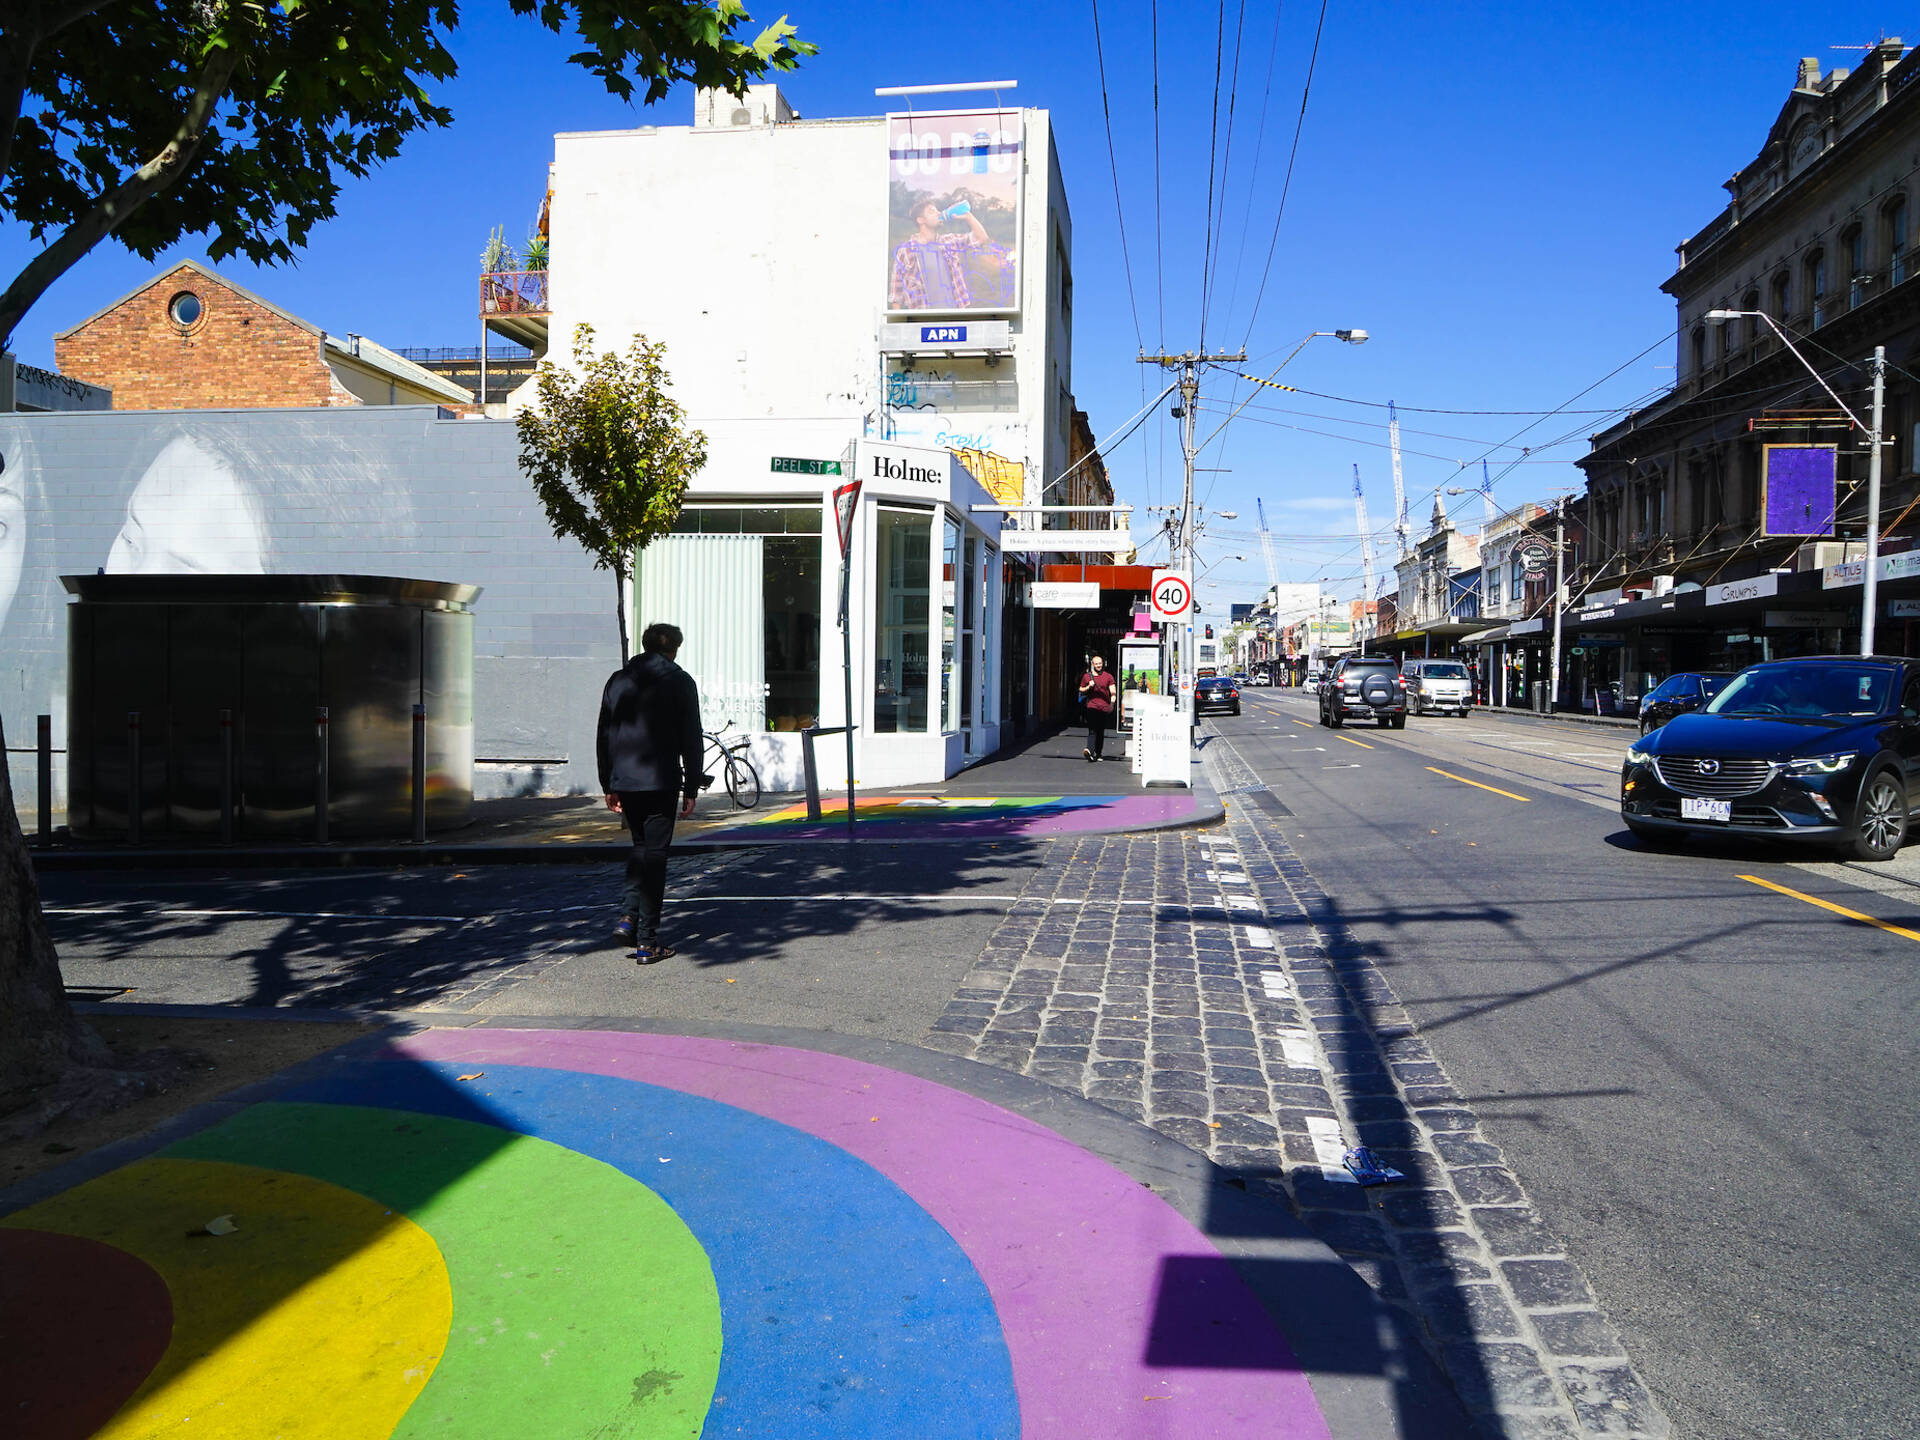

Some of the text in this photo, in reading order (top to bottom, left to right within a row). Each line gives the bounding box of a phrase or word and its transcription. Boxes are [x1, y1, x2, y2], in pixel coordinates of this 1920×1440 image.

[927, 328, 960, 341] APN
[774, 458, 804, 473] PEEL
[809, 460, 824, 474] ST
[873, 456, 943, 484] Holme:
[1832, 564, 1862, 579] ALTIUS
[1158, 588, 1183, 605] 40
